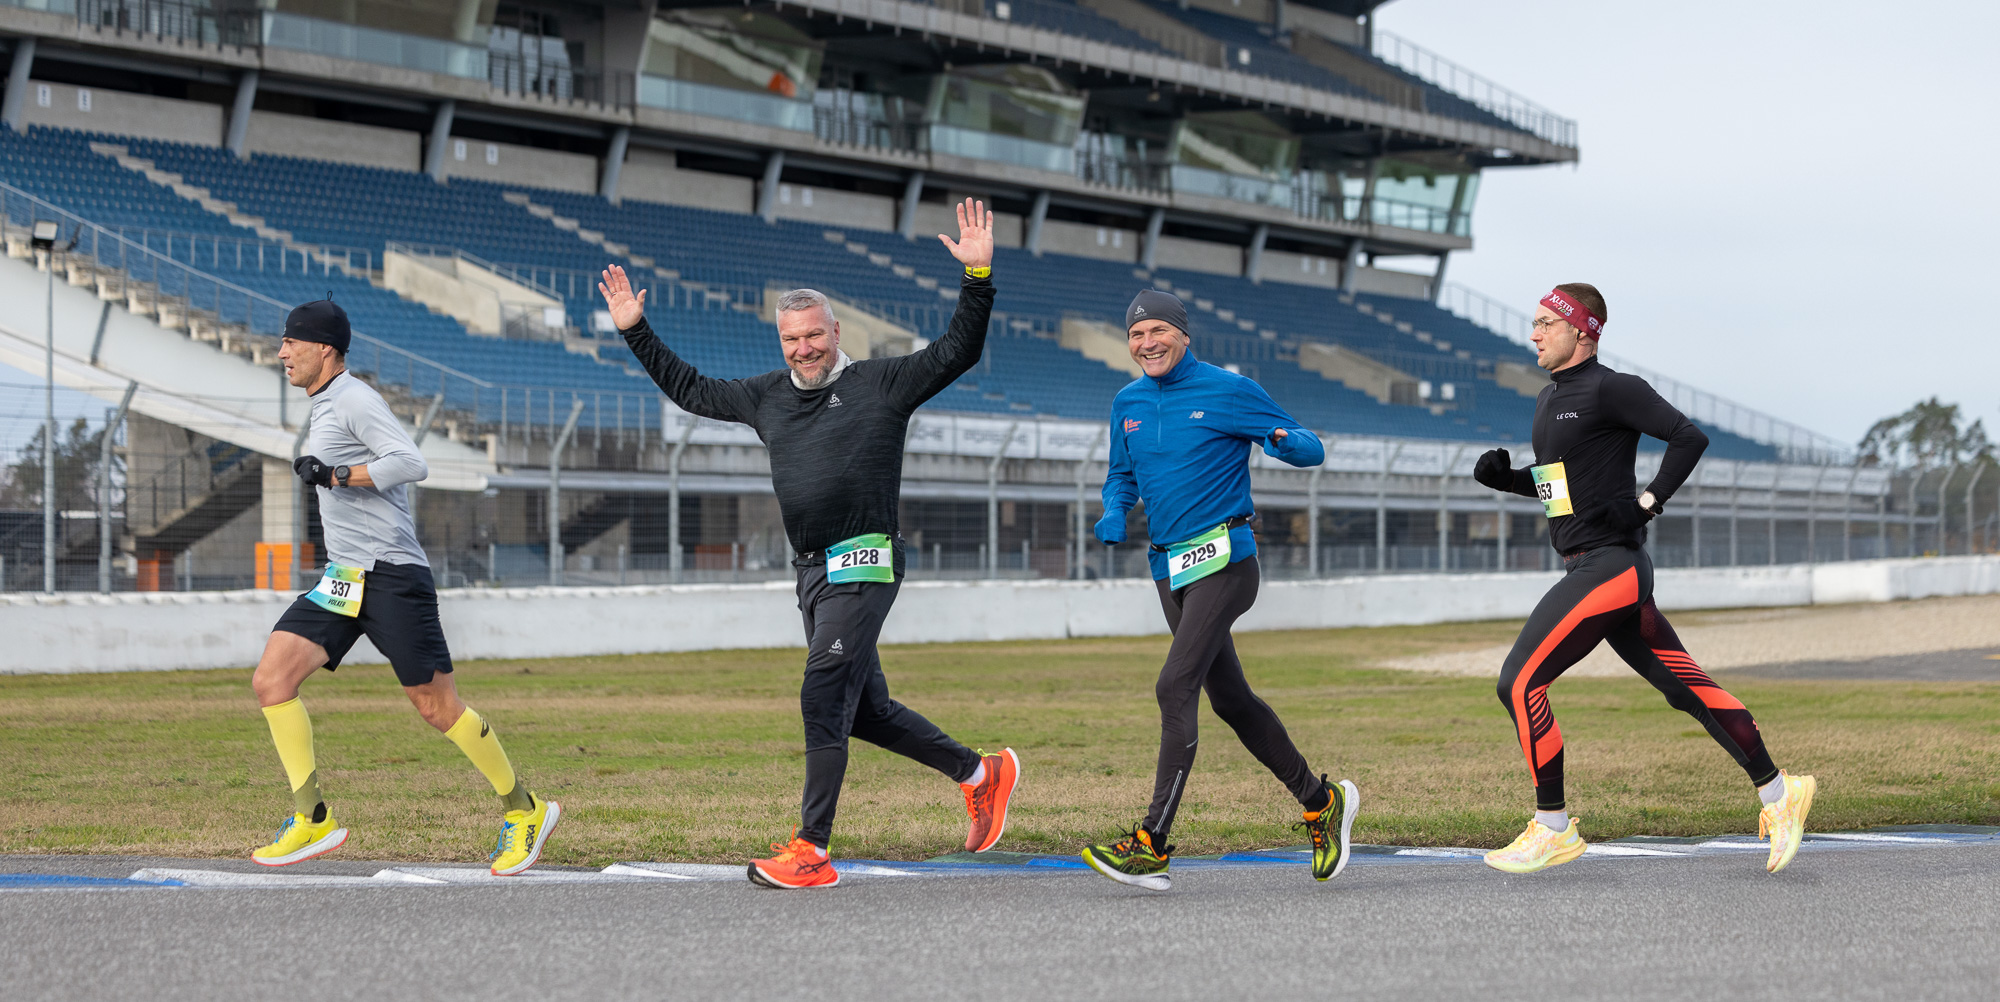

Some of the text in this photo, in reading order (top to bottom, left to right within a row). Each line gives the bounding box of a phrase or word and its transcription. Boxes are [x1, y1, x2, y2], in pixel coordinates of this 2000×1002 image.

[1549, 293, 1575, 314] XLETIX
[1188, 411, 1205, 419] NB
[1564, 411, 1579, 419] COL
[841, 548, 879, 568] 2128
[1181, 542, 1217, 570] 2129
[331, 579, 351, 598] 337
[524, 824, 537, 854] HOKA
